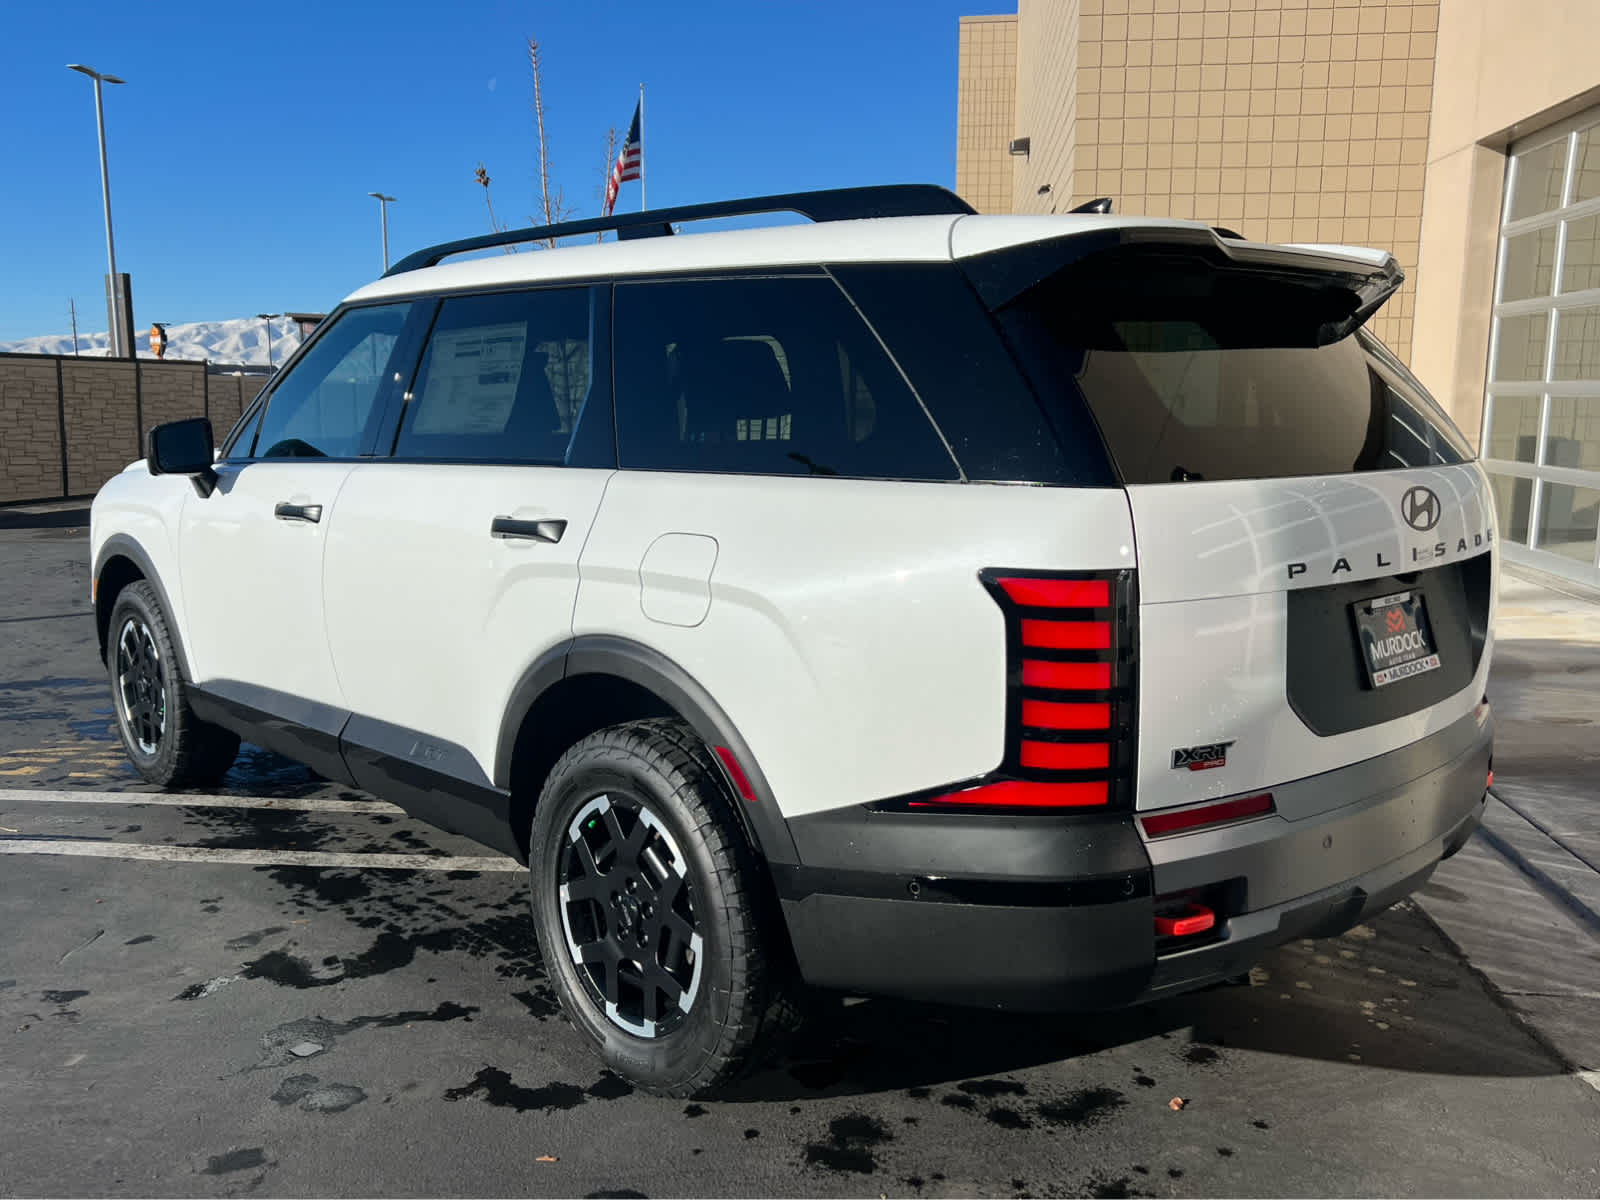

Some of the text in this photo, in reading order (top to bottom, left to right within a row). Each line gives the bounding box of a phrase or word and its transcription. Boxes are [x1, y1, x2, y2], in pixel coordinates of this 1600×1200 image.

[1288, 529, 1493, 579] PALISADE
[1370, 629, 1426, 661] MURDOCK
[1388, 660, 1426, 680] MURDOCK
[1170, 740, 1236, 769] XRT
